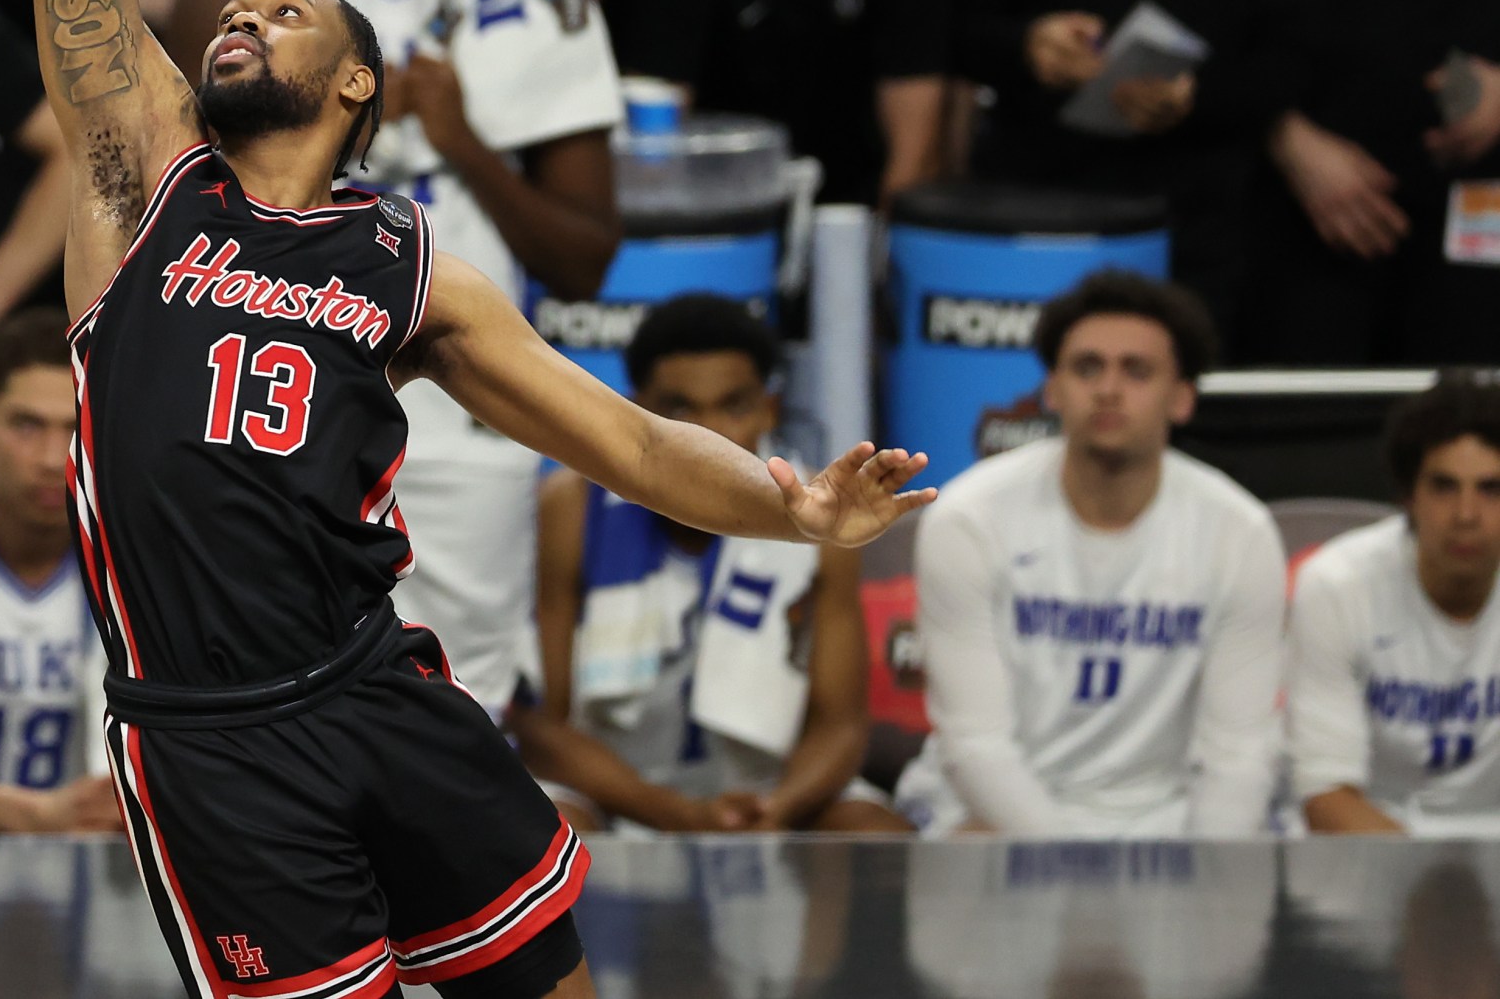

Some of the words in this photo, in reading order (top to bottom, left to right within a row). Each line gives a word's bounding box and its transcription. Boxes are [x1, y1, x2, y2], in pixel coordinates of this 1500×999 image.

[161, 232, 391, 349] Houston
[204, 332, 317, 456] 13
[216, 934, 269, 978] UH
